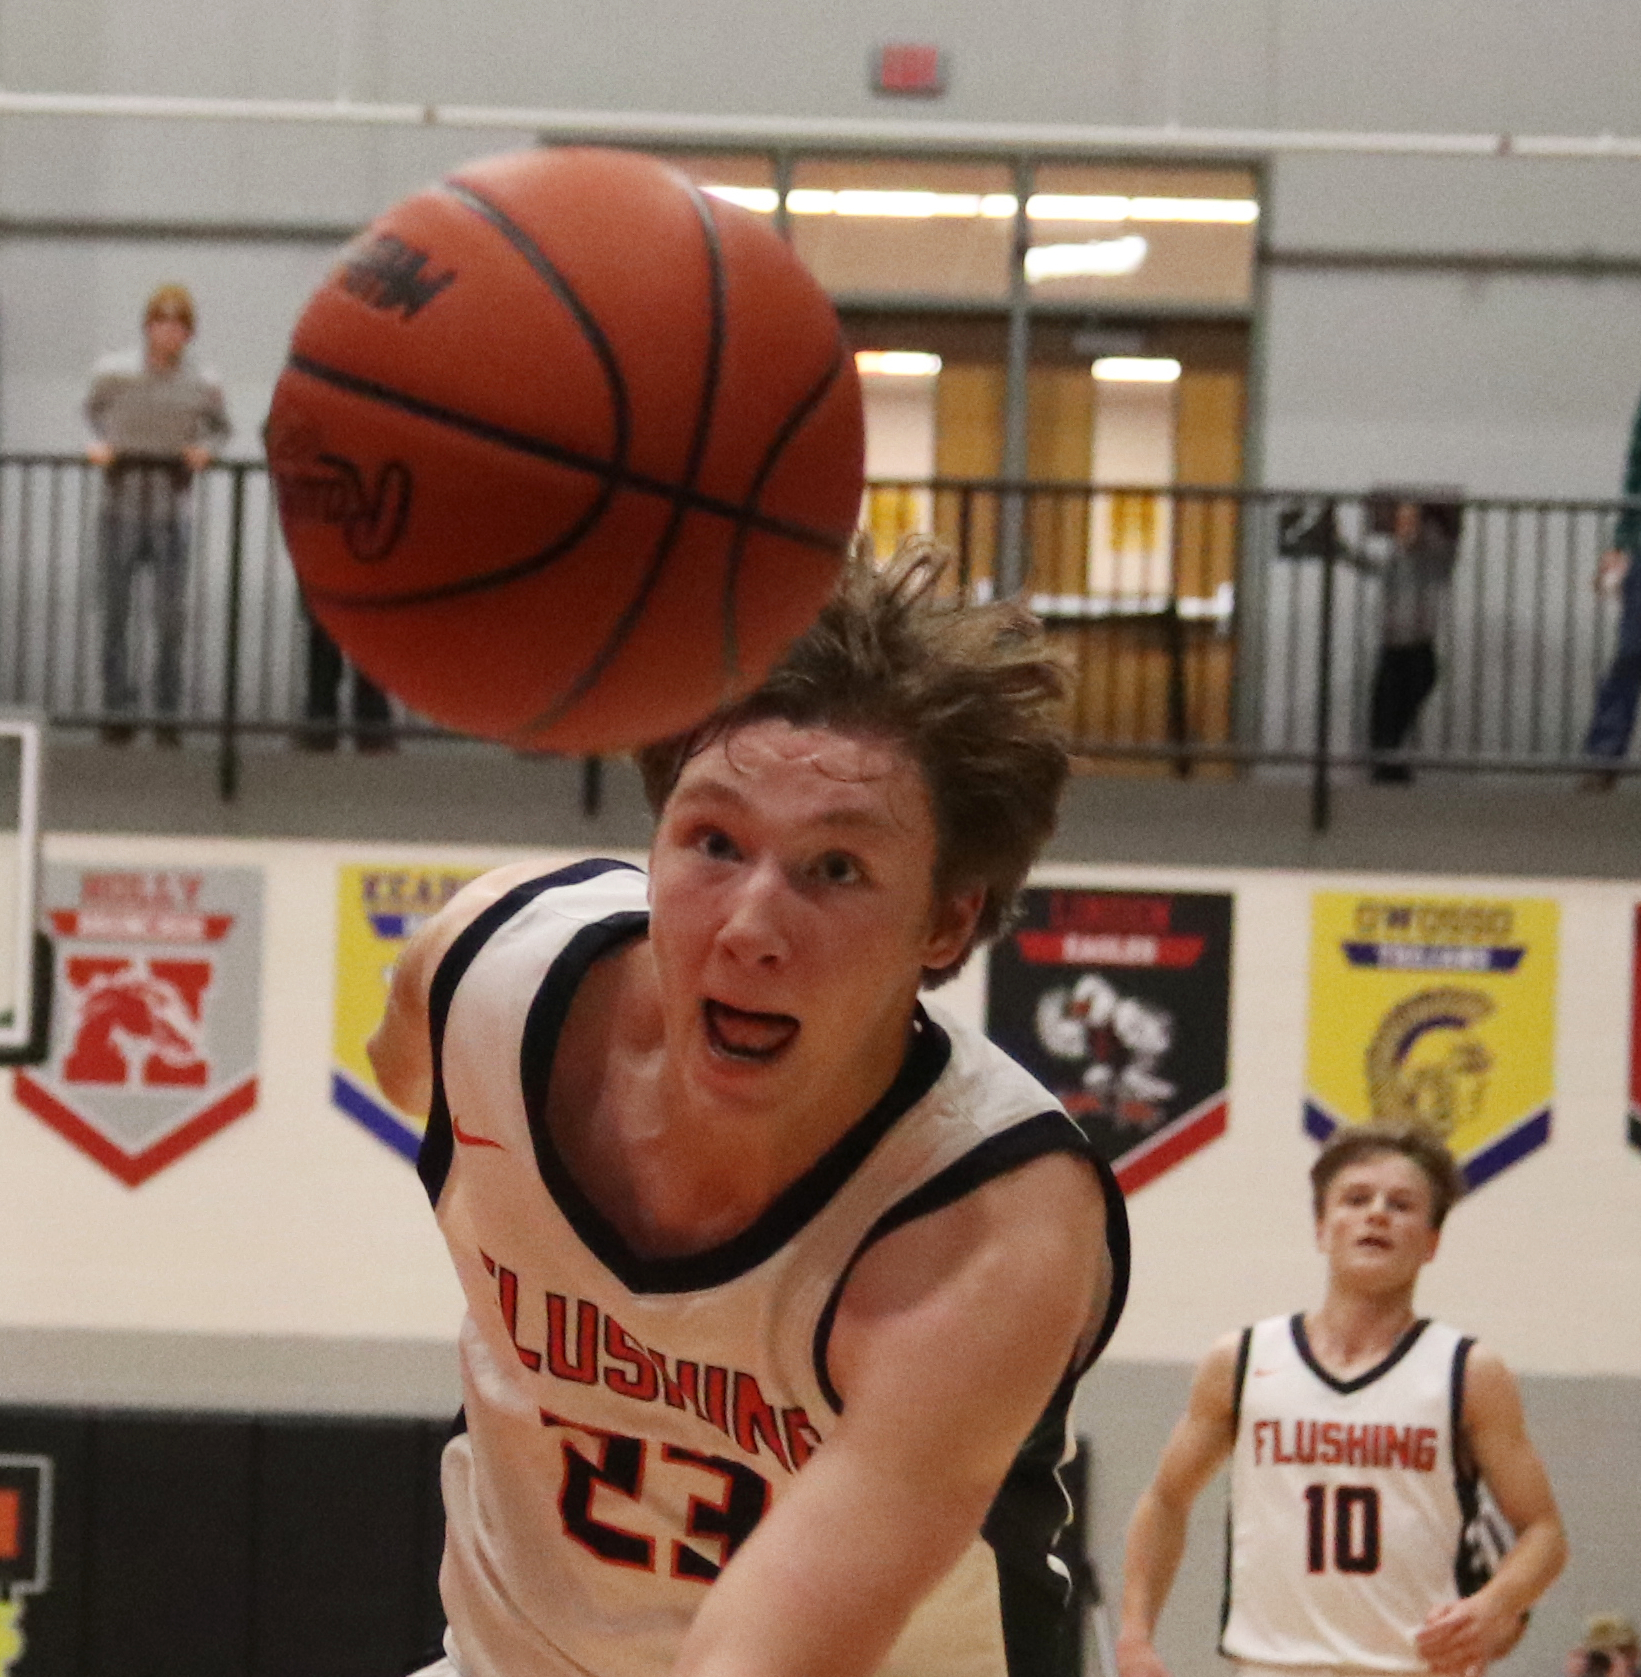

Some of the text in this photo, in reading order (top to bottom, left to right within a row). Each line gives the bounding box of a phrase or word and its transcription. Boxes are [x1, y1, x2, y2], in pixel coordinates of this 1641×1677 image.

[477, 1246, 823, 1476] LUSHING
[538, 1405, 774, 1586] 23
[1252, 1418, 1439, 1473] FLUSHING
[1303, 1482, 1382, 1577] 10
